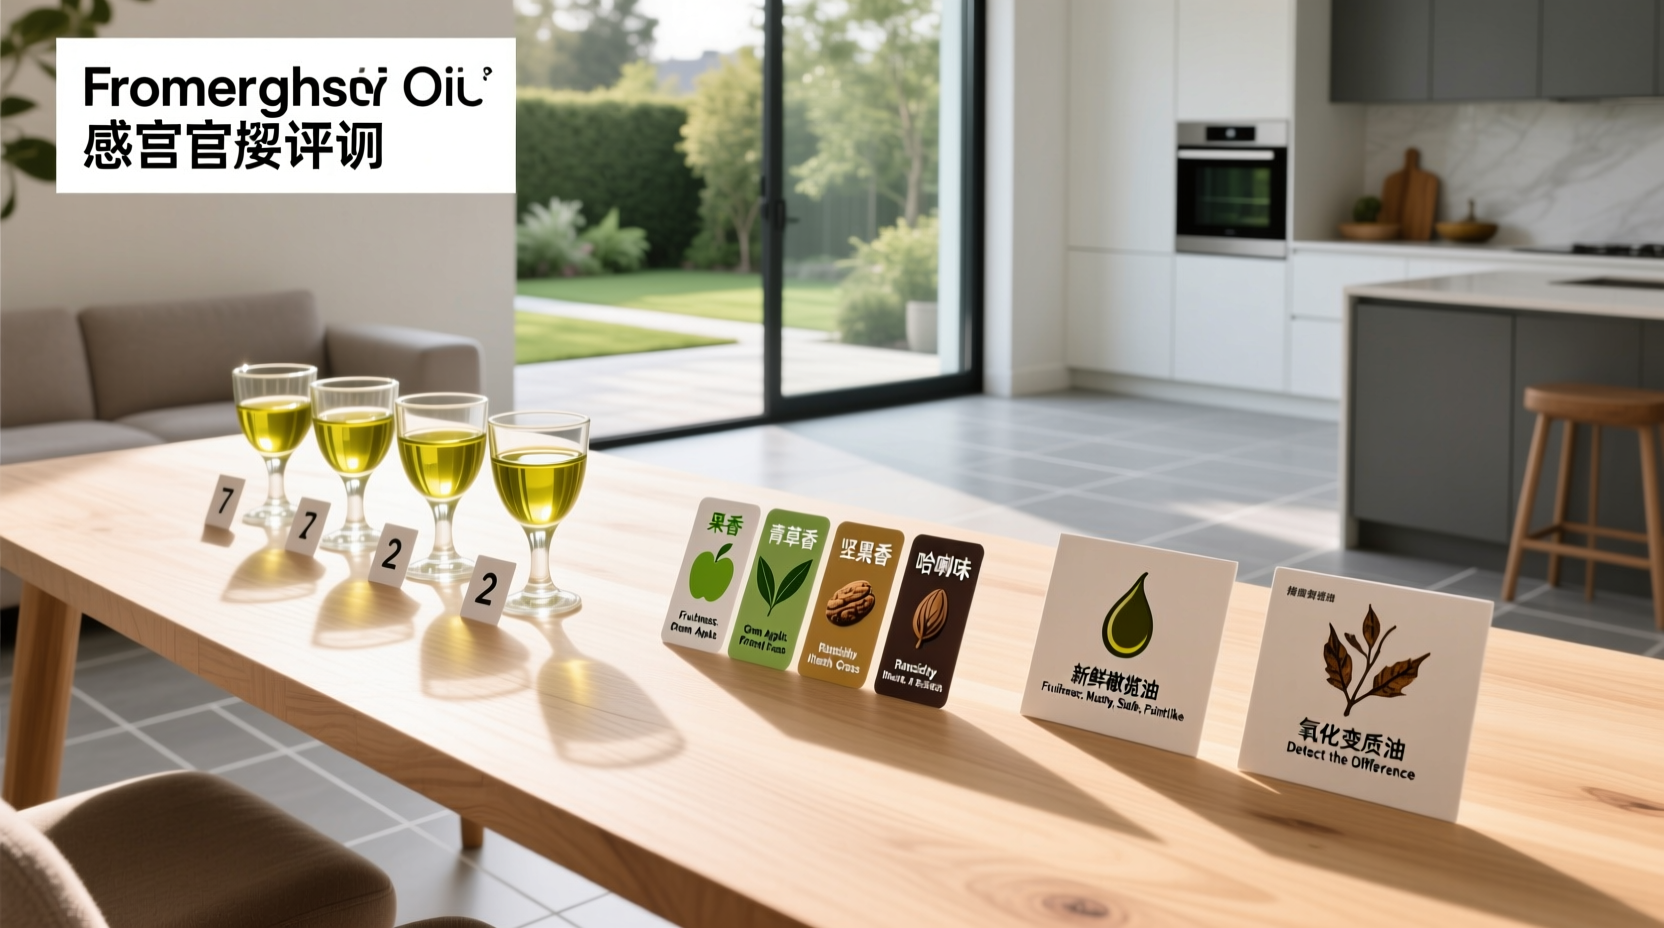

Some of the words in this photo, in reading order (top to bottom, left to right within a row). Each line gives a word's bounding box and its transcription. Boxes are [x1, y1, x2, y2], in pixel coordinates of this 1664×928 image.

[707, 512, 744, 536] 果香
[769, 523, 819, 550] 青草香
[381, 538, 402, 570] 2
[839, 538, 893, 566] 坚果香
[474, 572, 498, 606] 2
[1298, 716, 1406, 762] 氧化变质油
[1329, 750, 1348, 765] the
